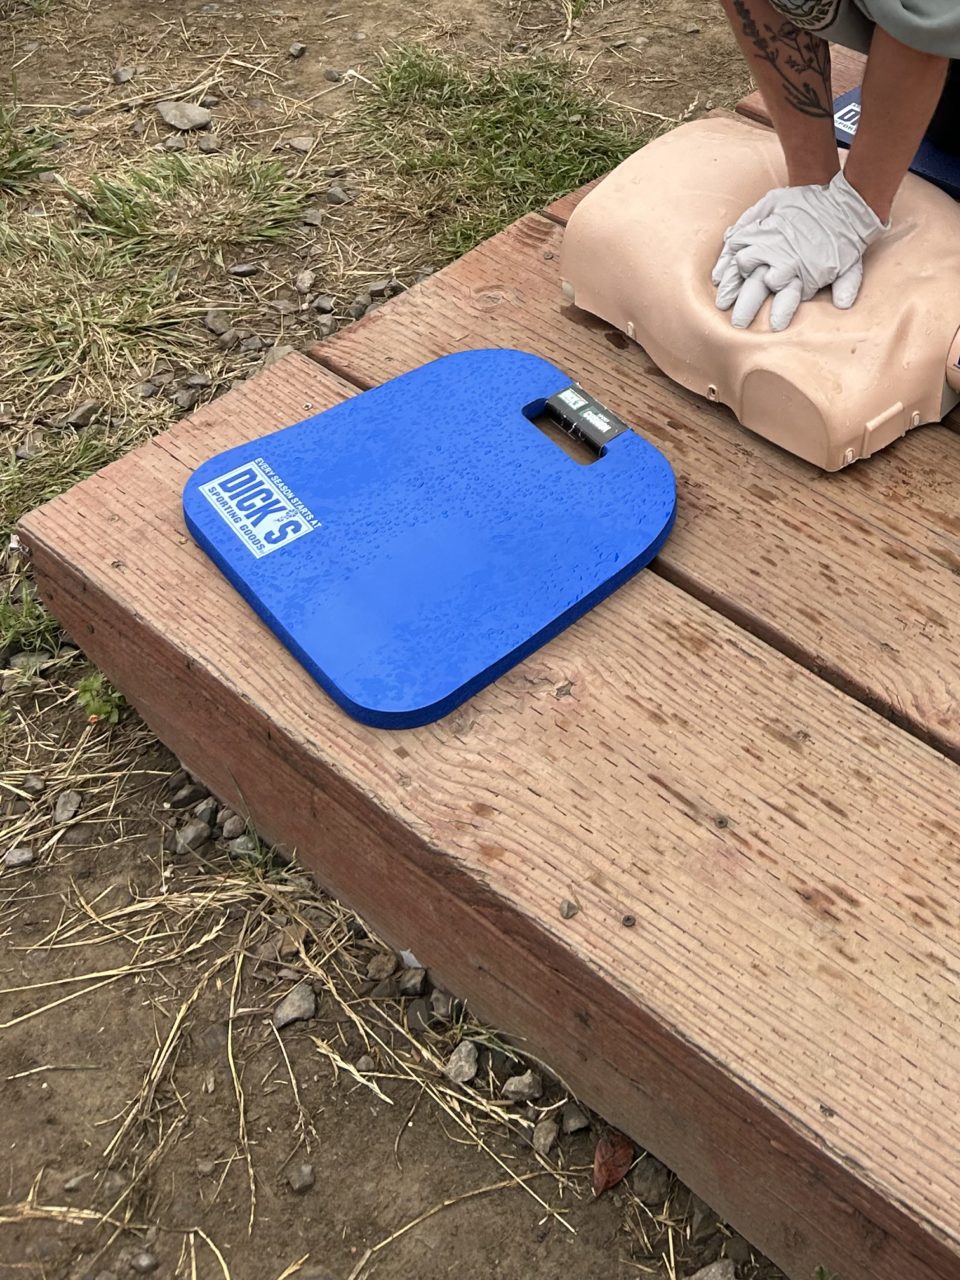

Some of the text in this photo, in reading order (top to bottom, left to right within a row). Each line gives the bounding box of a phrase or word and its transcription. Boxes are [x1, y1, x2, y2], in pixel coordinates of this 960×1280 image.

[208, 486, 266, 551] SPORTING GOODS
[254, 457, 322, 529] EVERY SEASON STARTS AT
